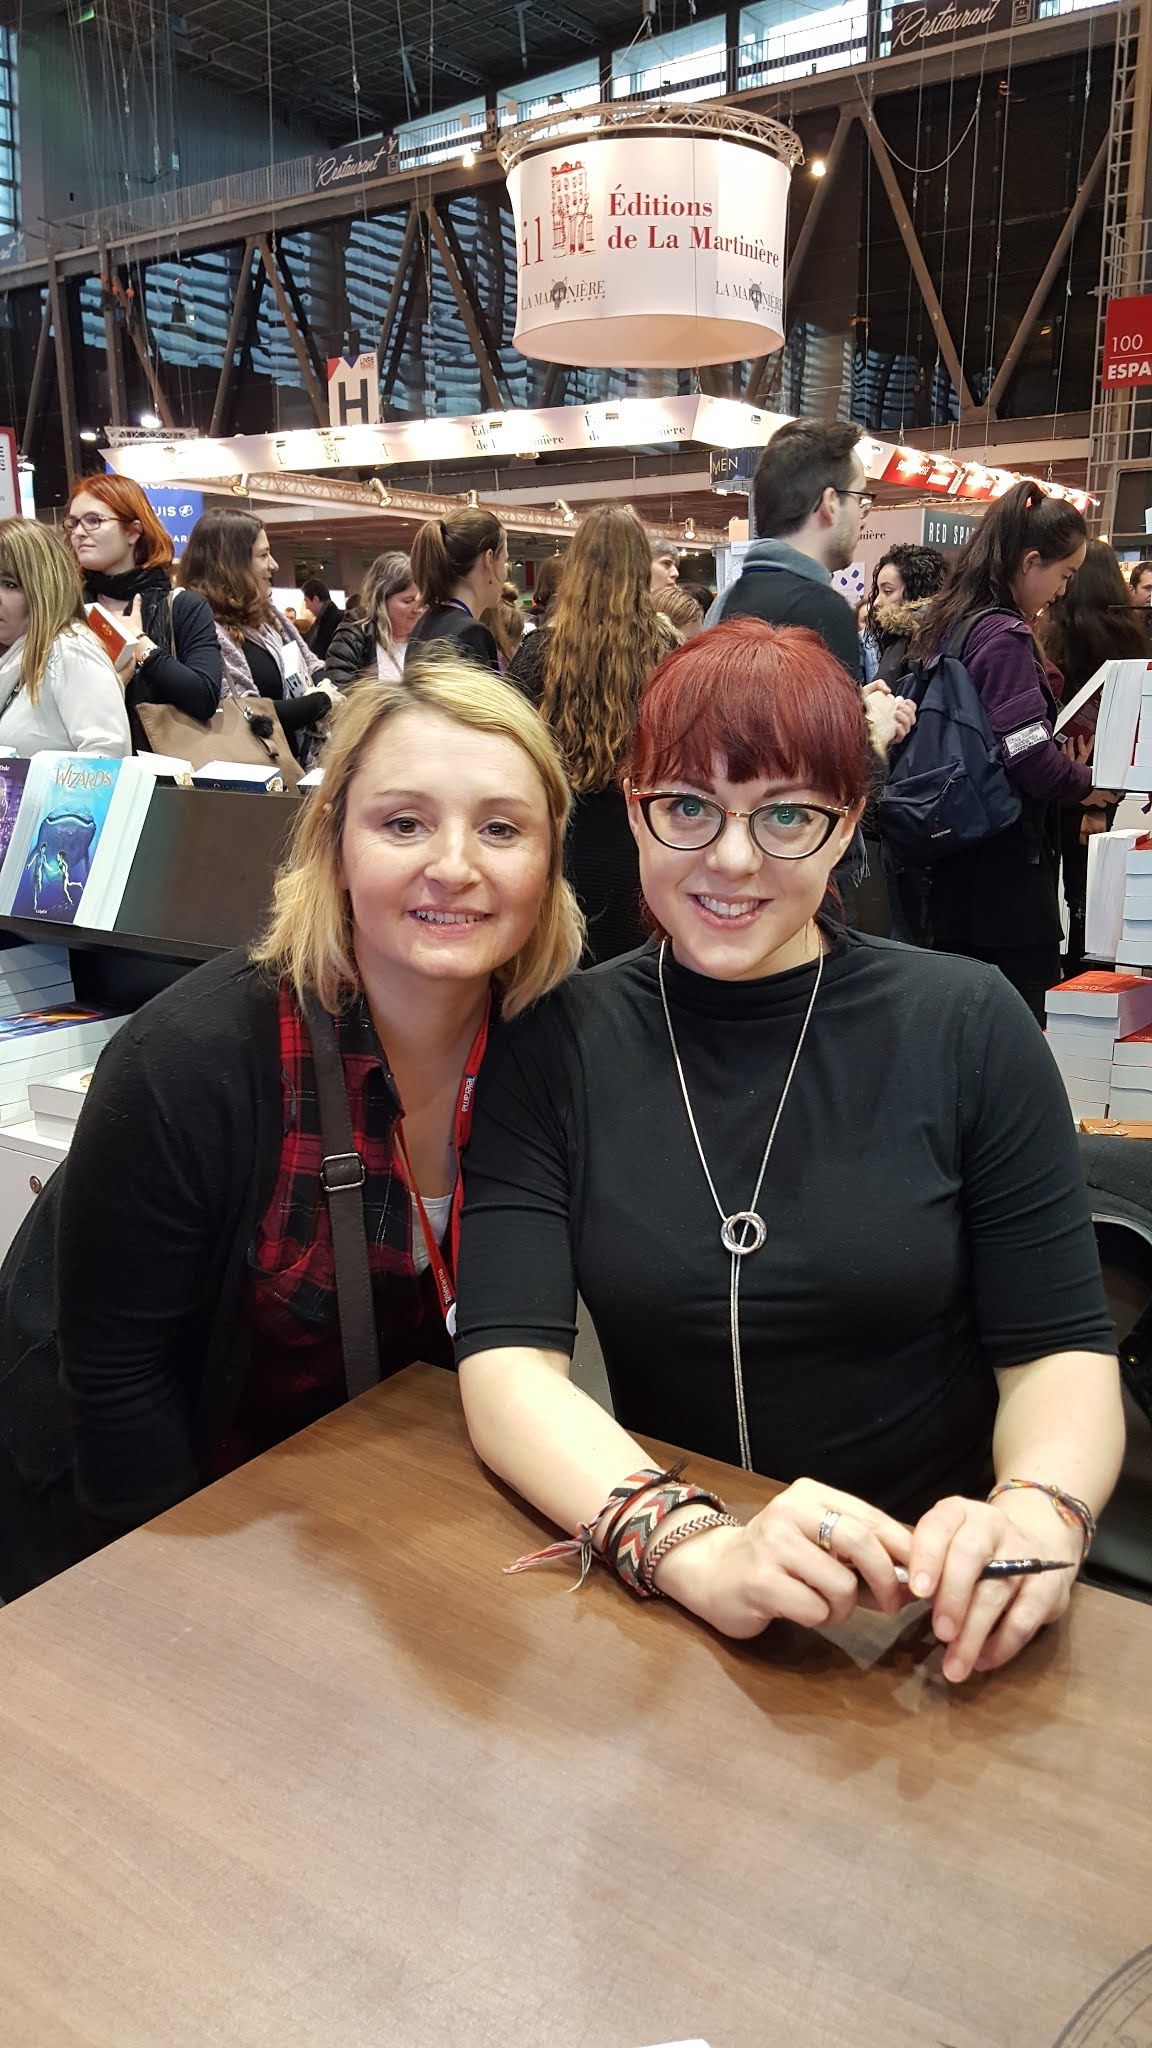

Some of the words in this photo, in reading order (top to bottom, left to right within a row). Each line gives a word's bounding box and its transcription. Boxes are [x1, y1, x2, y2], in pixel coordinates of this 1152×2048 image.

[892, 0, 1000, 48] Restaurant
[315, 147, 386, 187] Restaurant
[607, 184, 713, 217] Éditions
[607, 227, 638, 250] de
[647, 226, 679, 250] La
[689, 226, 780, 268] Martinière
[520, 296, 532, 311] LA
[534, 280, 606, 306] MARTINIÈRE
[715, 280, 730, 296] LA
[1112, 334, 1143, 352] 100
[338, 378, 370, 426] H
[928, 521, 947, 543] RED
[55, 763, 114, 790] WIZARDS
[461, 1076, 477, 1113] Télérama
